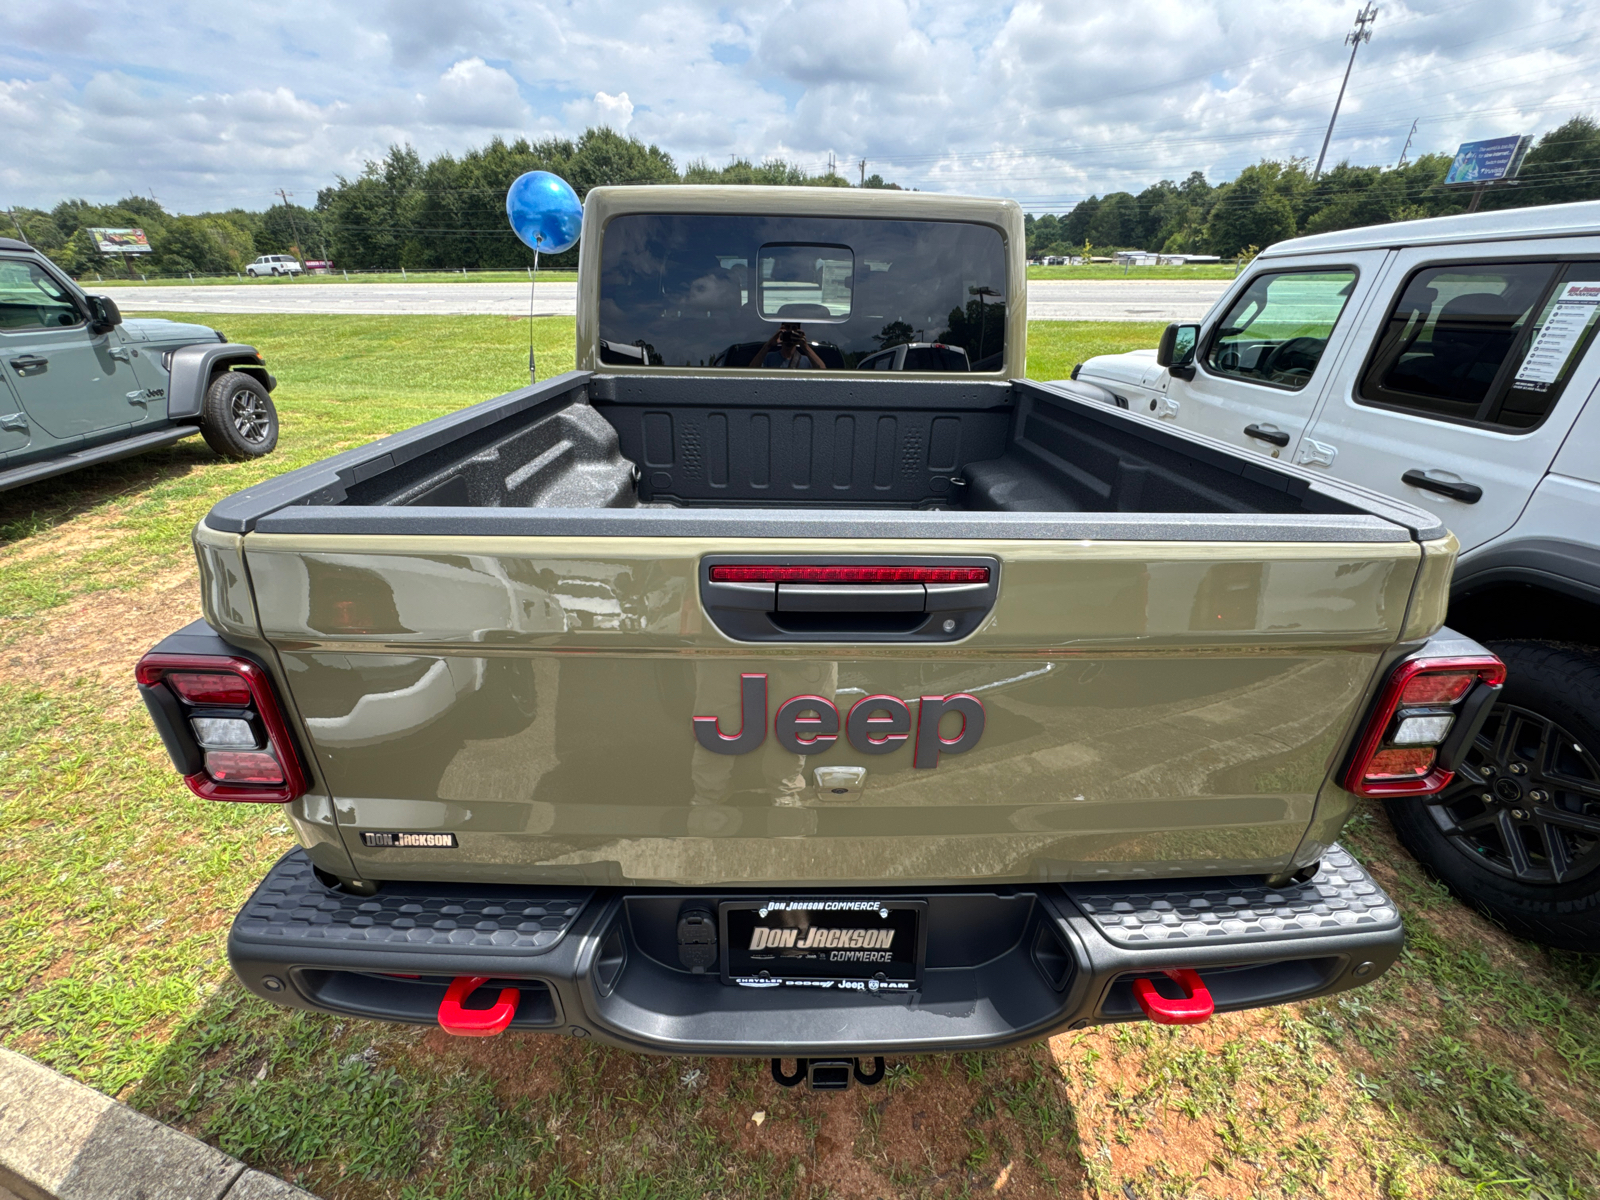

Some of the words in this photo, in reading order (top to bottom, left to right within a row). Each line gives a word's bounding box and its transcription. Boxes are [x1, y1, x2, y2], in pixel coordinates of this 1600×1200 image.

[146, 389, 164, 398] Jeep
[693, 673, 986, 769] Jeep
[365, 832, 393, 846] DON
[395, 832, 452, 847] JACKSON
[767, 902, 786, 911] DON
[786, 902, 825, 911] JACKSON
[825, 901, 881, 911] COMMERCE
[750, 926, 799, 951] DON
[797, 926, 896, 949] JACKSON
[829, 951, 893, 963] COMMERCE
[838, 979, 865, 991] Jeep
